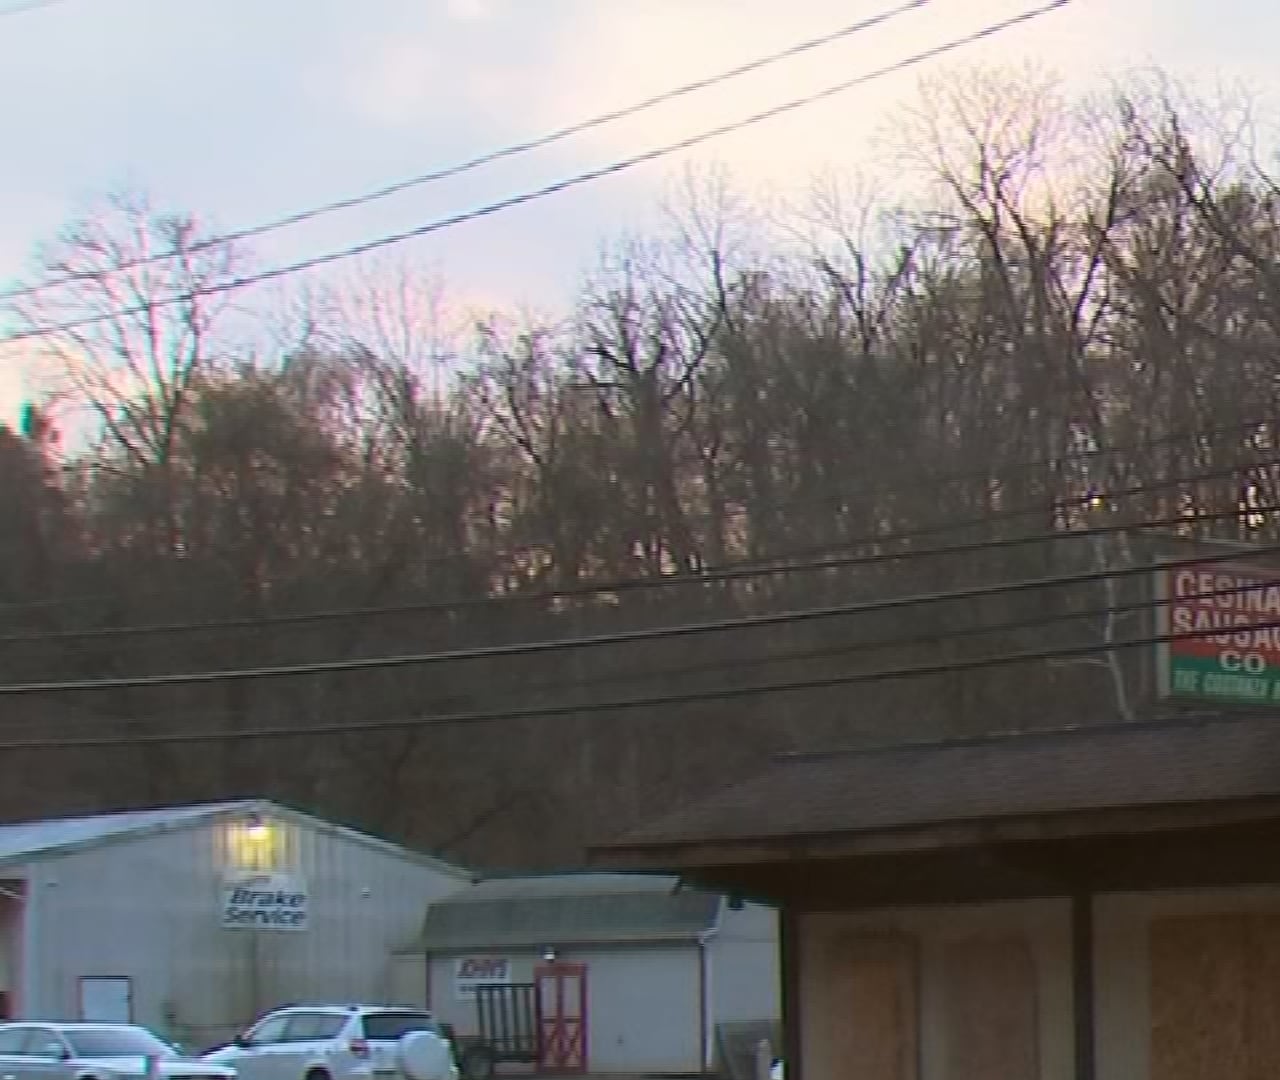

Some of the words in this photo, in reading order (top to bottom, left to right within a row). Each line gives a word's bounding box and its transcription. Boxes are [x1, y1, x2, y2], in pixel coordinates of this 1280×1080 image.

[1219, 649, 1266, 674] CO
[230, 888, 306, 908] Brake
[222, 906, 306, 926] Service
